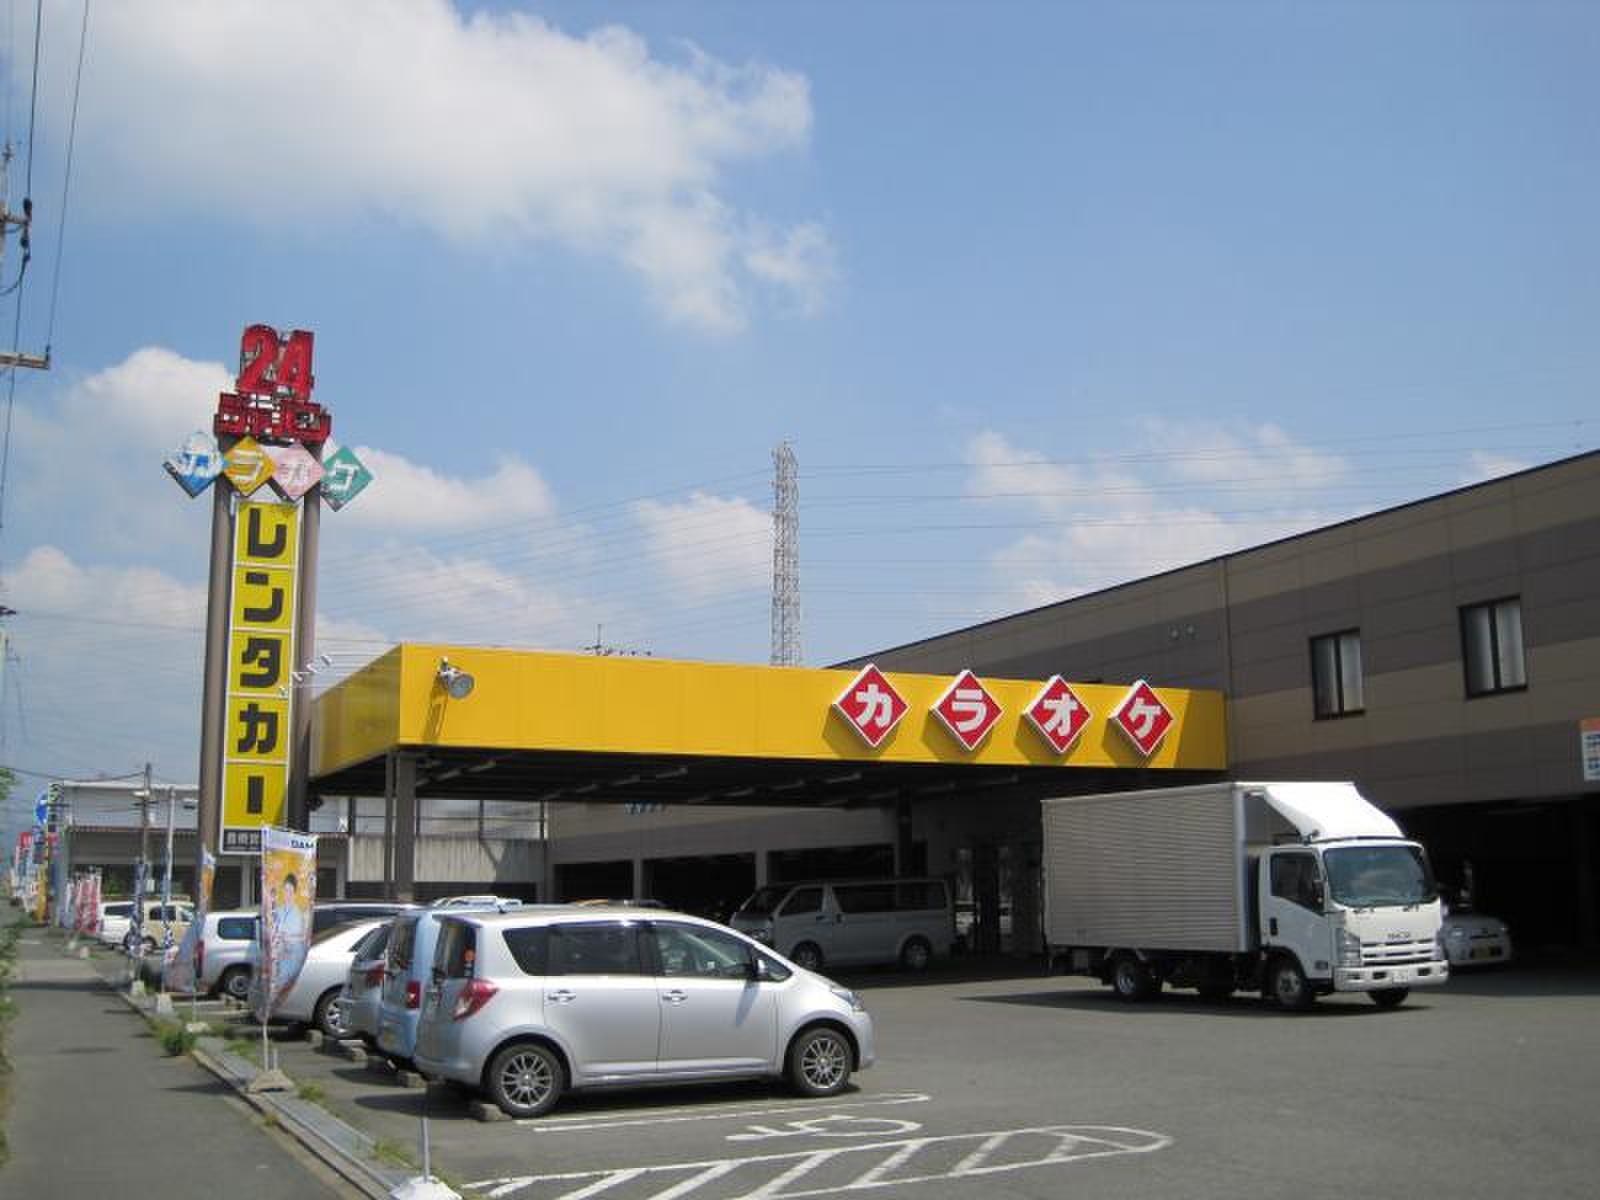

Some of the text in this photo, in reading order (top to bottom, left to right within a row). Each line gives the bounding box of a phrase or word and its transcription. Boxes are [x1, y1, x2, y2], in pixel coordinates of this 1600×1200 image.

[240, 323, 314, 399] 24
[237, 508, 287, 815] レンタカー
[853, 680, 1163, 741] カラオケ
